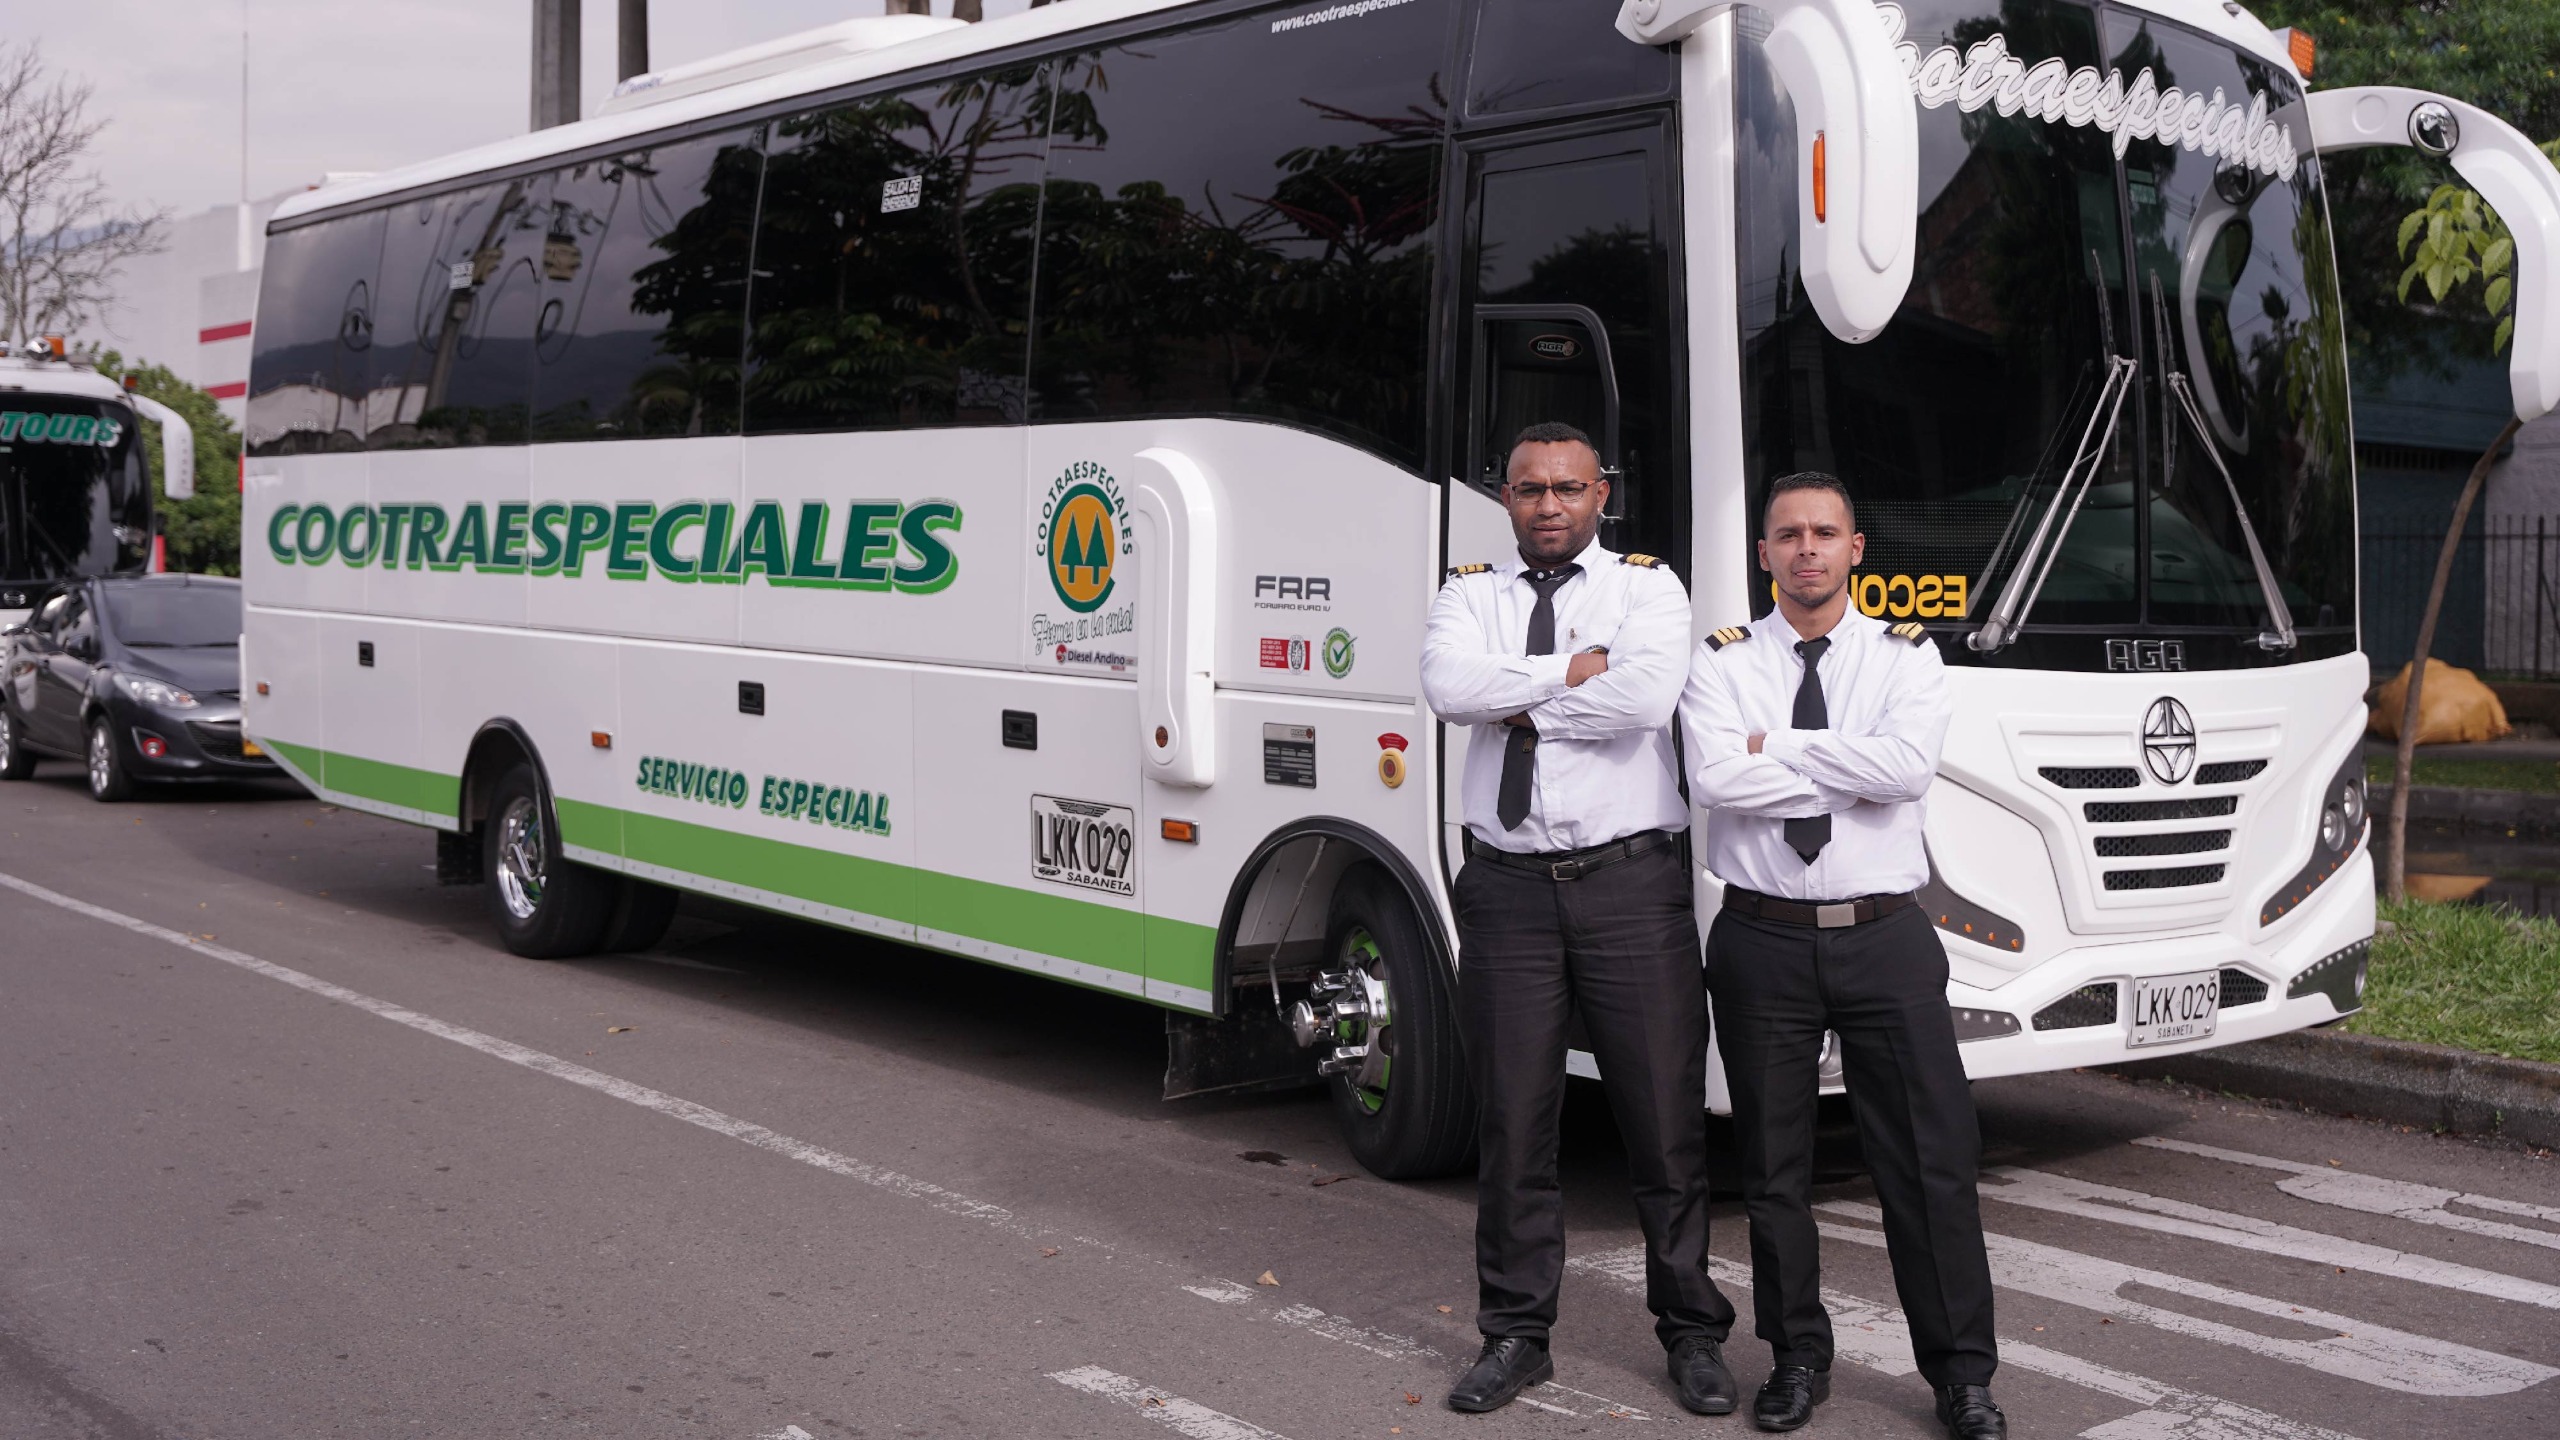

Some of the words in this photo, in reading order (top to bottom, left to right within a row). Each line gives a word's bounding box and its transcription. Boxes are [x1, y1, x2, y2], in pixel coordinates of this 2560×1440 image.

[1271, 0, 1415, 33] www.cootraespecia
[1, 411, 123, 448] TOURS
[1036, 461, 1132, 556] COOTRAESPECIALES
[267, 498, 964, 595] COOTRAESPECIALES
[1255, 575, 1331, 601] FRR
[1254, 602, 1296, 610] FORWARD
[1297, 604, 1321, 612] EURO
[1032, 613, 1073, 656] Firmes
[1076, 618, 1088, 641] en
[1090, 609, 1103, 639] la
[1067, 650, 1092, 662] Diesel
[1094, 651, 1125, 665] Andino
[2105, 638, 2186, 671] AGA
[636, 756, 749, 811] SERVICIO
[759, 774, 891, 837] ESPECIAL
[1067, 872, 1132, 893] SABANETA
[2157, 1024, 2193, 1038] SABANETA
